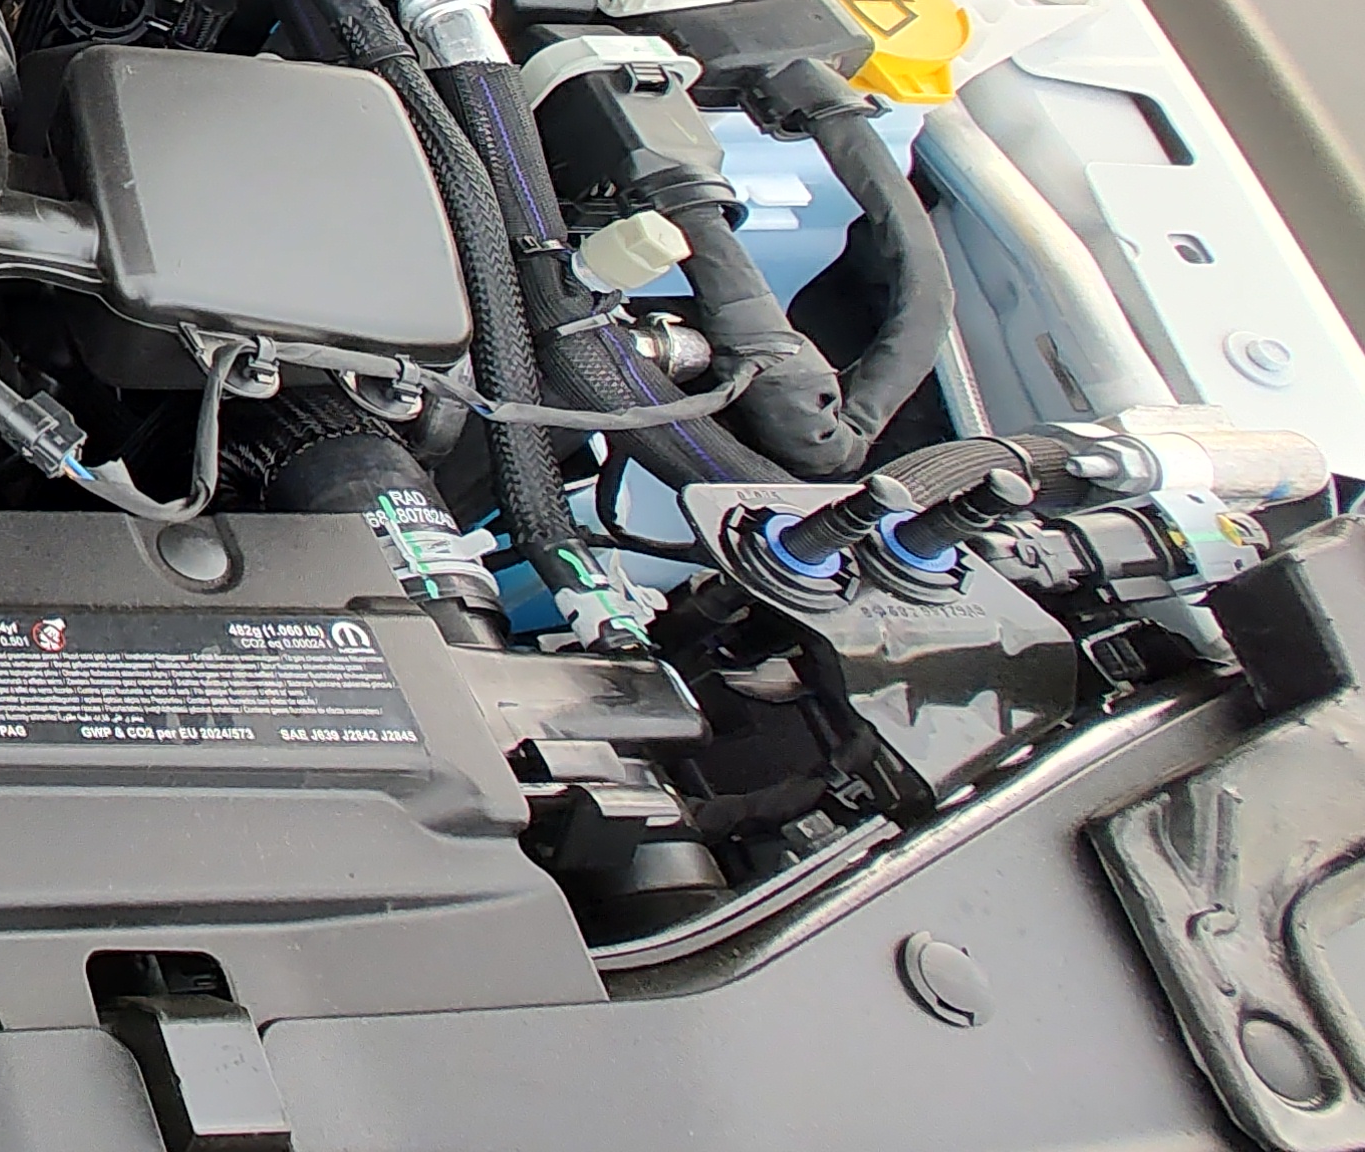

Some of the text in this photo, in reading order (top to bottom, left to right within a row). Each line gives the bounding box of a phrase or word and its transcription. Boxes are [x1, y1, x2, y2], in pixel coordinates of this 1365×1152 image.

[388, 489, 427, 506] RAD
[228, 623, 325, 639] 482g (1.060 lb)
[0, 635, 30, 647] 0.501
[240, 638, 266, 649] CO2
[267, 640, 282, 651] eq
[0, 725, 28, 738] PAG
[81, 726, 112, 739] GWP
[126, 727, 155, 739] CO2
[155, 728, 177, 744] per
[179, 728, 199, 740] EU
[200, 728, 255, 741] 2024/573
[280, 729, 418, 743] SAE J639 J2842 J2845
